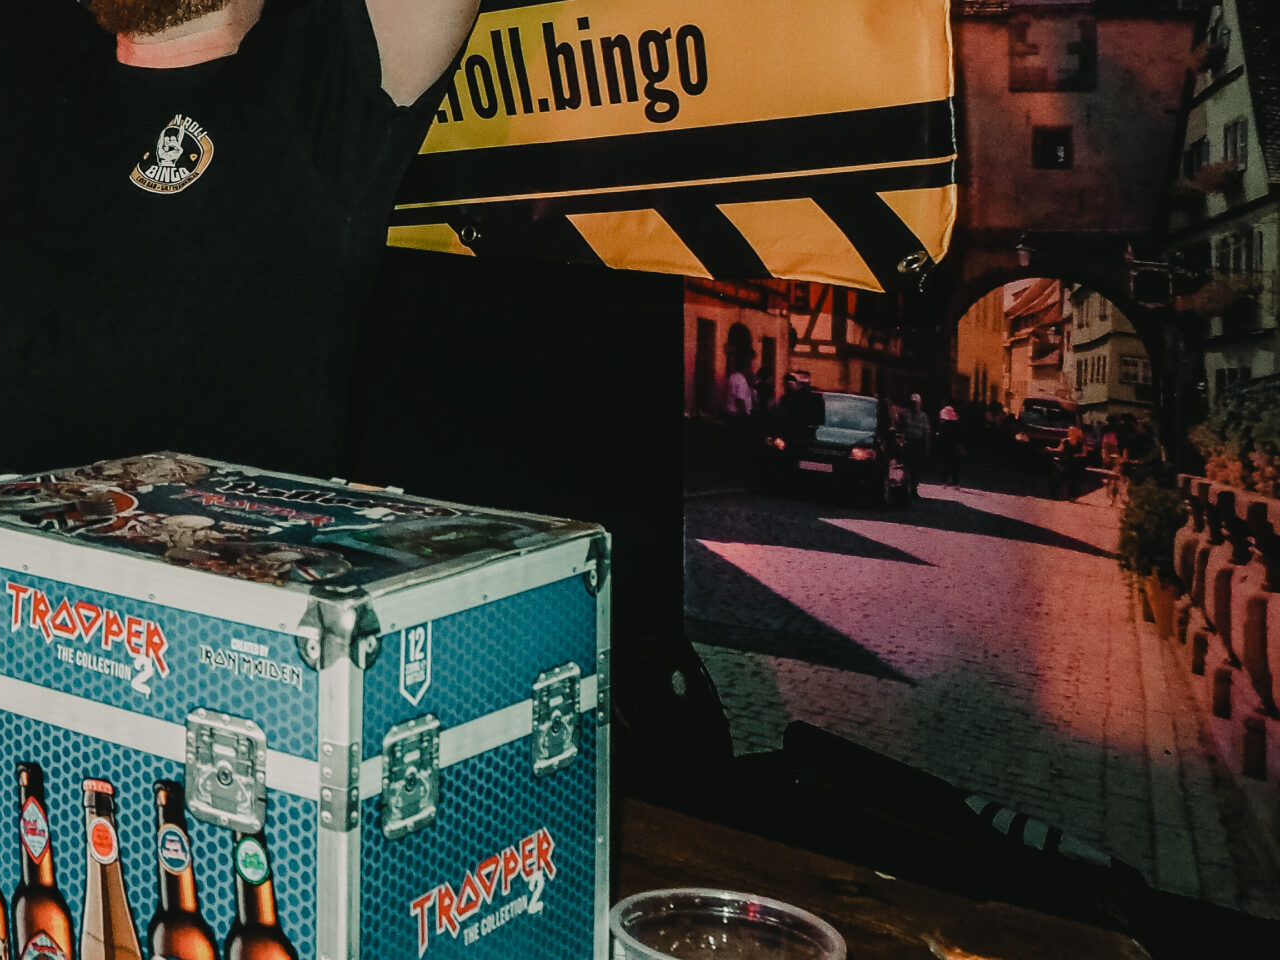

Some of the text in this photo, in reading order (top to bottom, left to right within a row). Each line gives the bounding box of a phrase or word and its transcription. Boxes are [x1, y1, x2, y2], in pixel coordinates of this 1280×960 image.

[183, 116, 208, 141] ROLL
[145, 165, 190, 182] BINGO
[6, 581, 170, 679] TROOPER
[408, 626, 425, 662] 12
[56, 643, 155, 700] THE COLLECTION 2
[200, 643, 303, 692] IRON MAIDEN
[409, 826, 557, 960] TROOPER
[463, 871, 545, 946] THE COLLECTION 2
